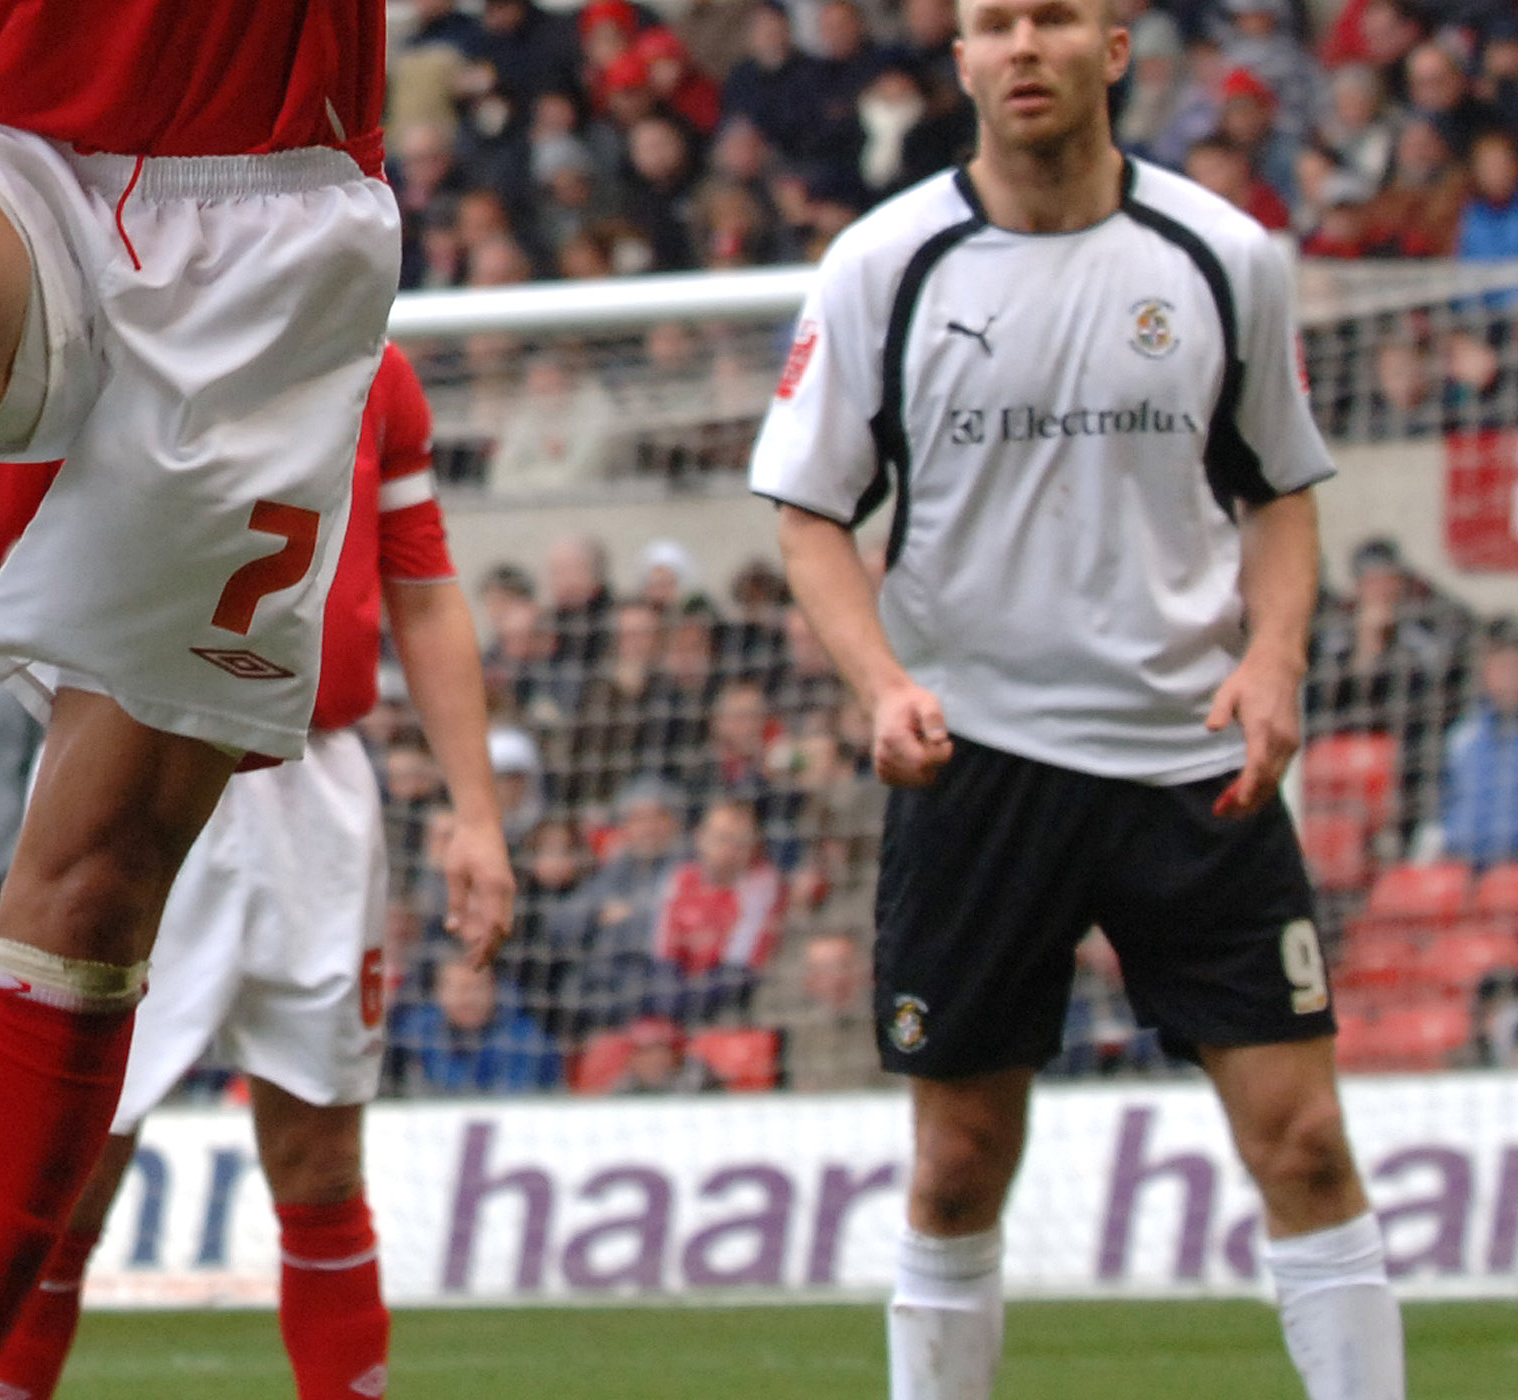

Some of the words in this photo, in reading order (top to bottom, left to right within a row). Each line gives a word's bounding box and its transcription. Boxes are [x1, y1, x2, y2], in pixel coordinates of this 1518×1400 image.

[211, 499, 321, 636] 7
[1282, 917, 1329, 1015] 9
[440, 1118, 902, 1292] haar
